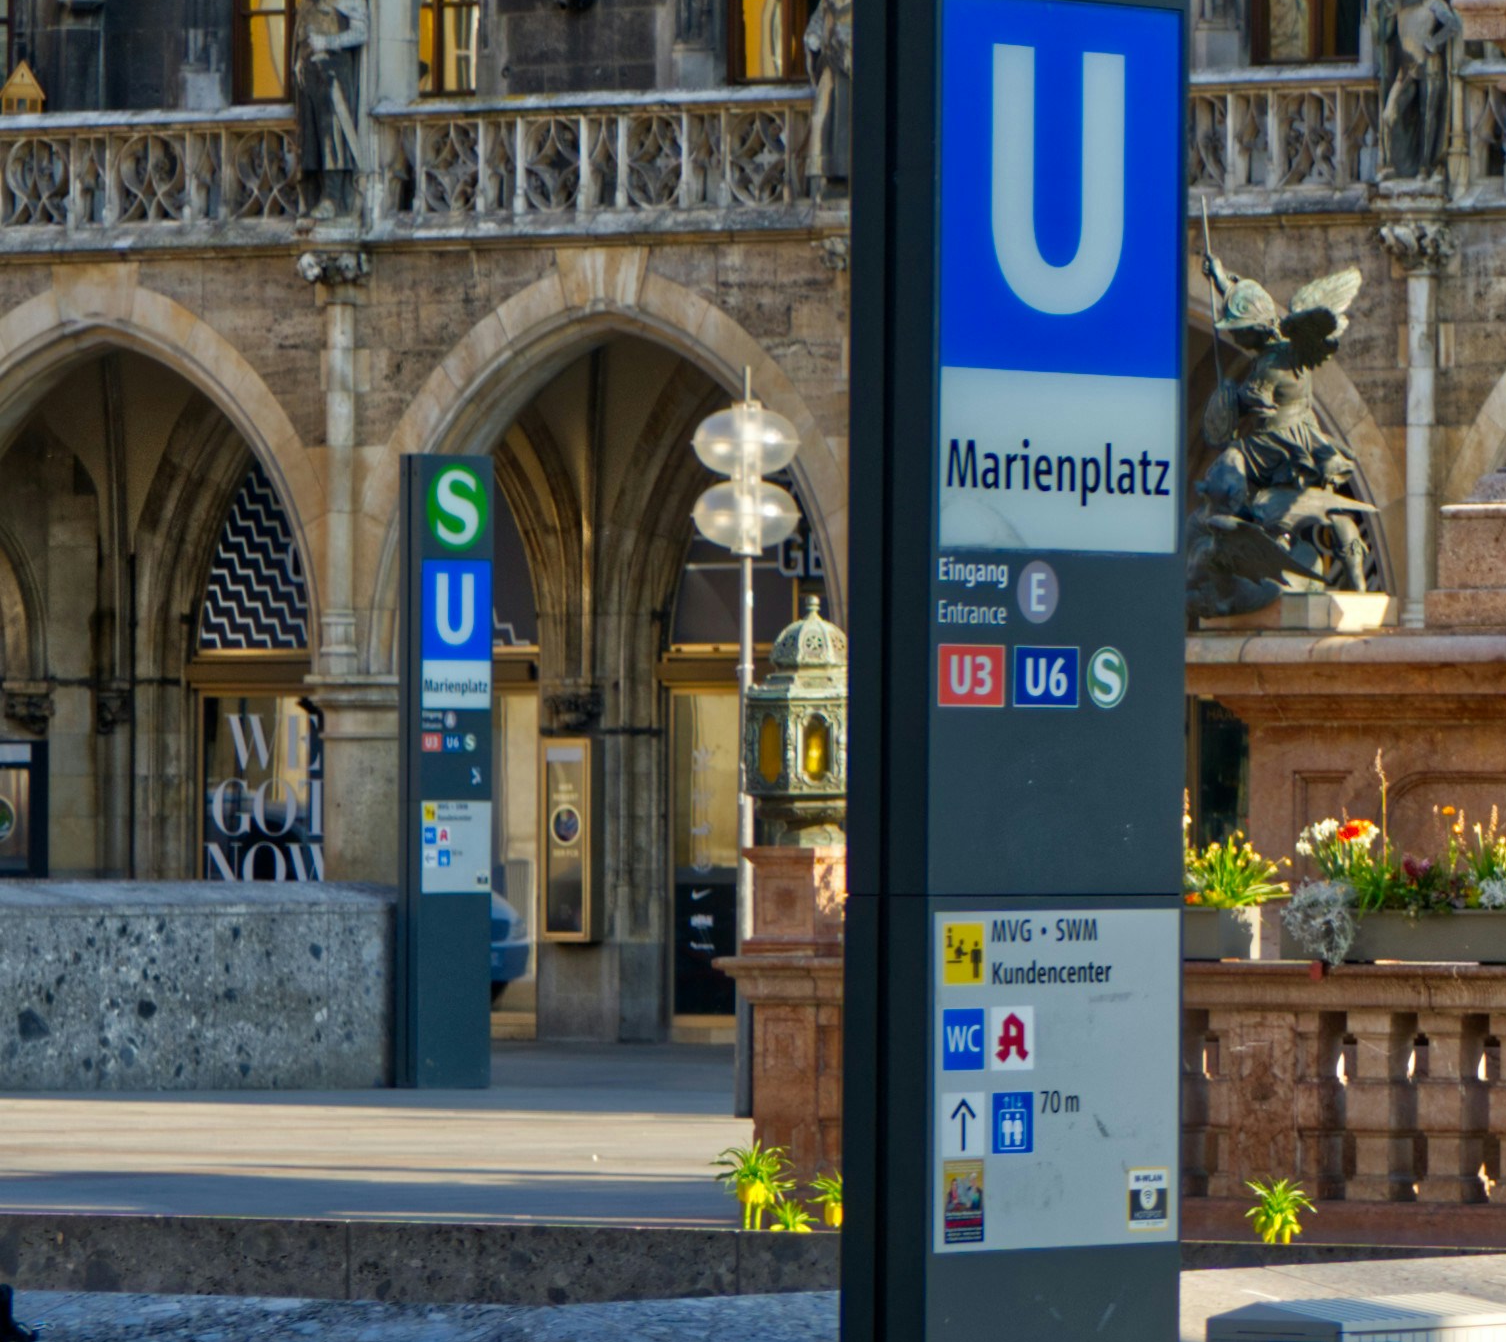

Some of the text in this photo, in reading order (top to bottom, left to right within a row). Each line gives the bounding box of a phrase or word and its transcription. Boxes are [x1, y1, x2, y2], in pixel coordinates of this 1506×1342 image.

[991, 43, 1126, 315] U
[946, 438, 1171, 507] Marienplatz
[435, 468, 478, 546] S
[937, 557, 1047, 613] Eingang E
[434, 572, 475, 646] U
[937, 600, 1008, 625] Entrance
[423, 679, 488, 697] Marienplatz
[949, 652, 1122, 703] U3 U6 S
[425, 735, 438, 750] U3
[446, 735, 459, 750] U6
[991, 917, 1099, 943] MVG SWM
[991, 960, 1113, 985] Kundencenter
[946, 1024, 981, 1054] WC
[1040, 1090, 1080, 1115] 70 m
